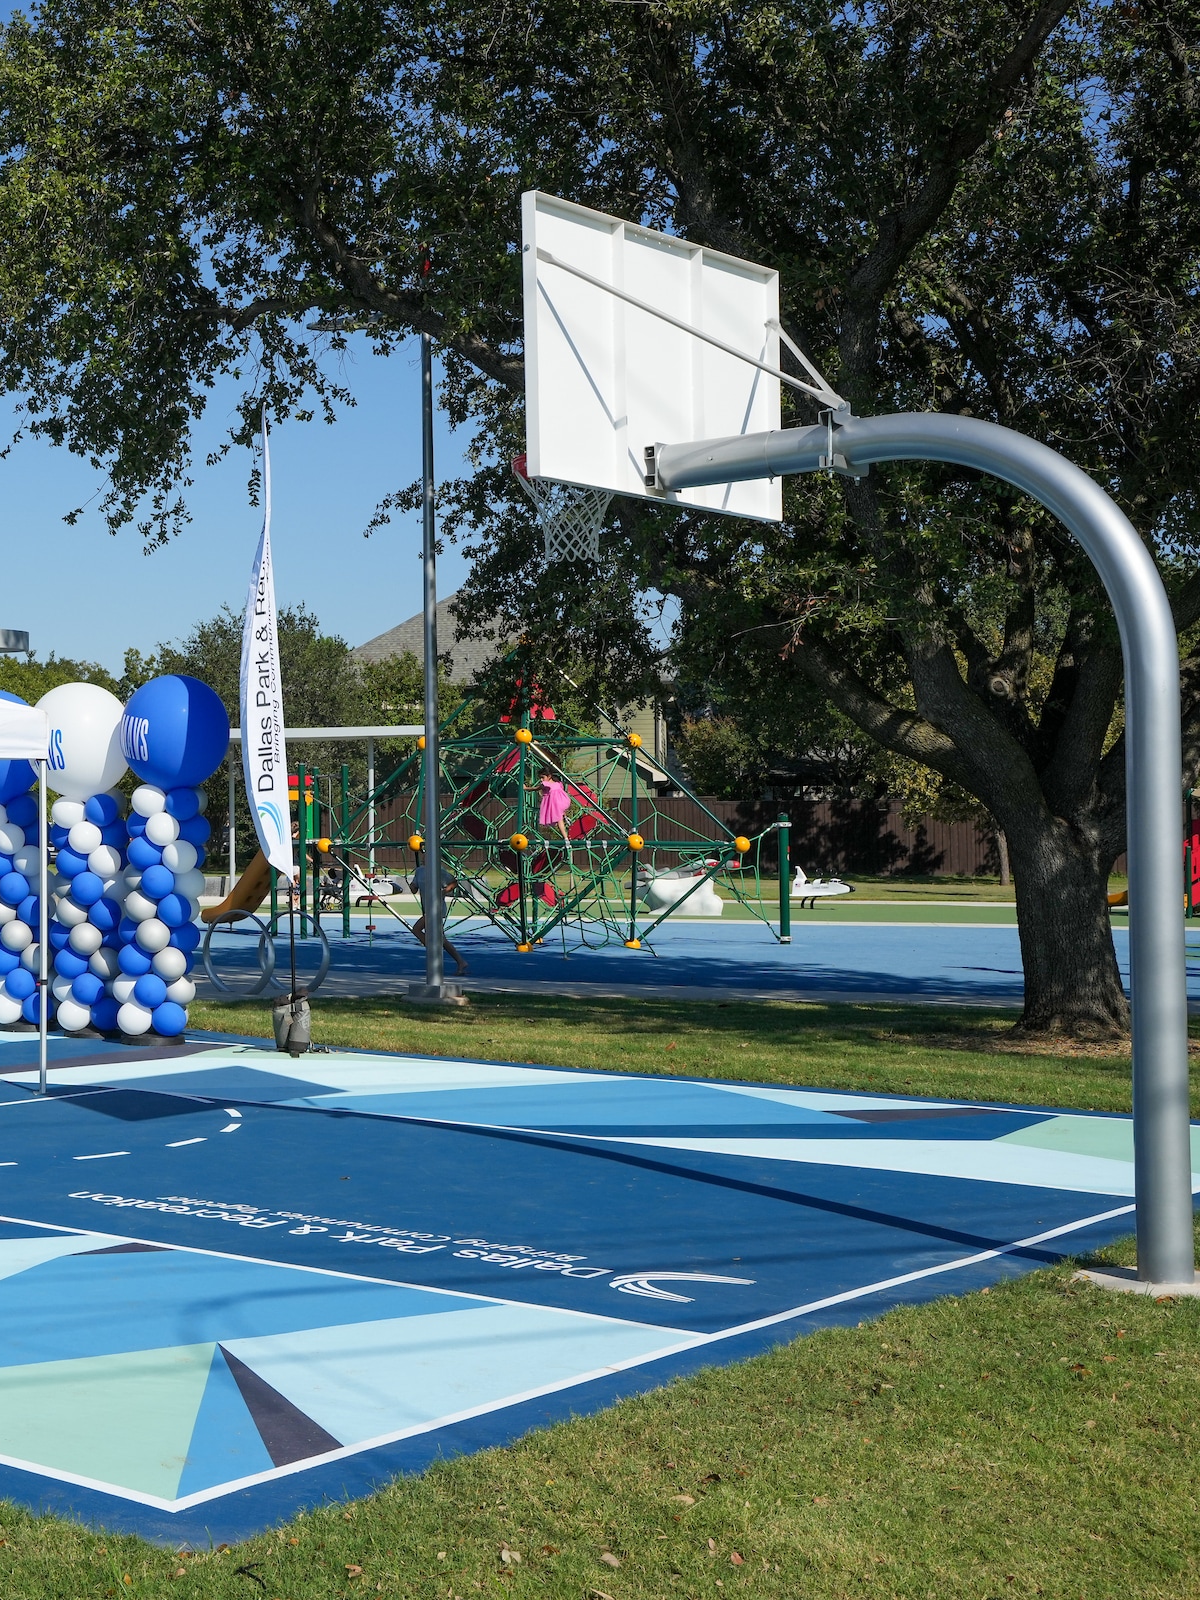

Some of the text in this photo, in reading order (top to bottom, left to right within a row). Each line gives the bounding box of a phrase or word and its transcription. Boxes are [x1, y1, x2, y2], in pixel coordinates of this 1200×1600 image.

[256, 624, 268, 642] &
[256, 651, 271, 707] Park
[120, 714, 149, 762] MAVS
[258, 715, 274, 792] Dallas
[273, 699, 281, 763] Bringing
[68, 1191, 614, 1279] Dallas Park & Recreation
[156, 1195, 588, 1262] Bringing Communities Together
